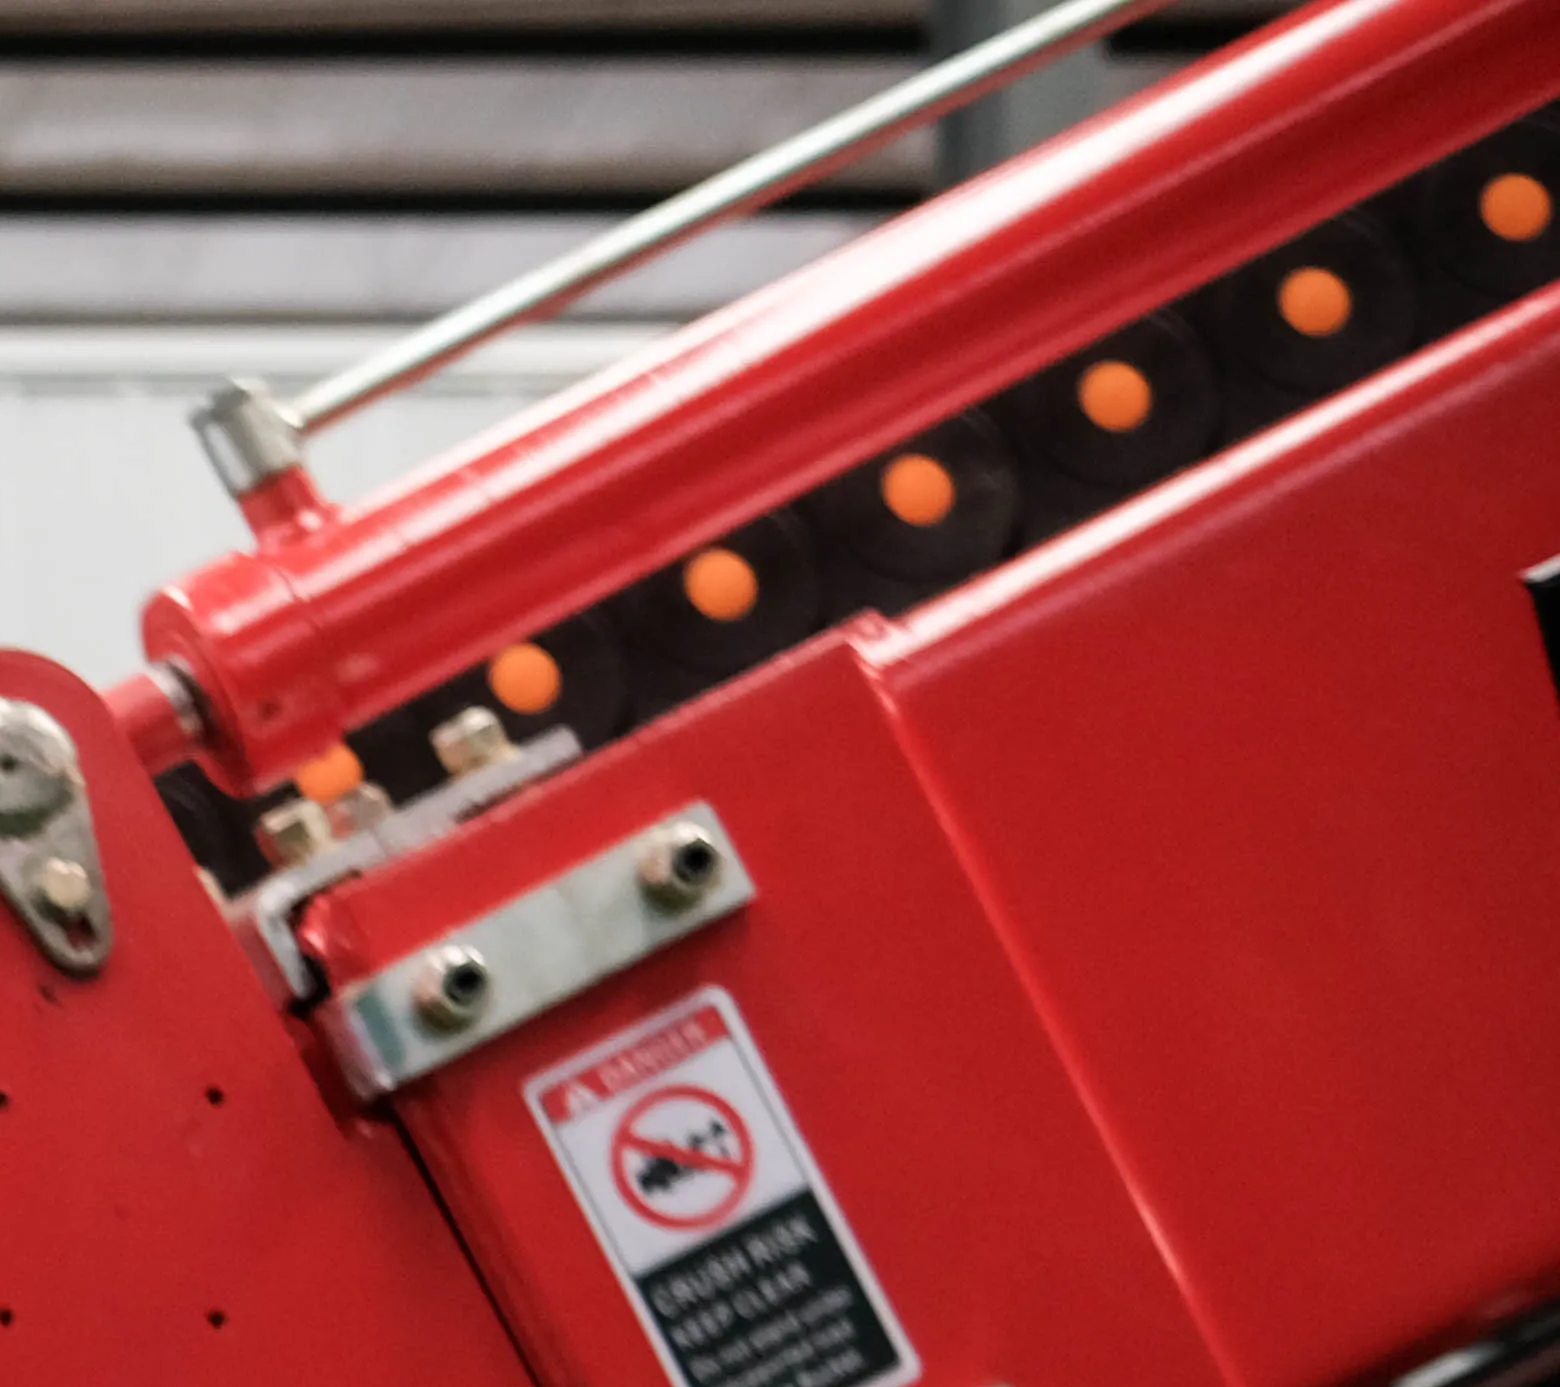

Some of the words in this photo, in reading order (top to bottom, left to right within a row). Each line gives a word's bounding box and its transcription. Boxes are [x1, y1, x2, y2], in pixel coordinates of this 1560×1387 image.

[651, 1249, 751, 1317] CRUSH
[745, 1215, 815, 1265] RISK
[669, 1300, 733, 1348] KEEP
[731, 1261, 811, 1318] CLEAR
